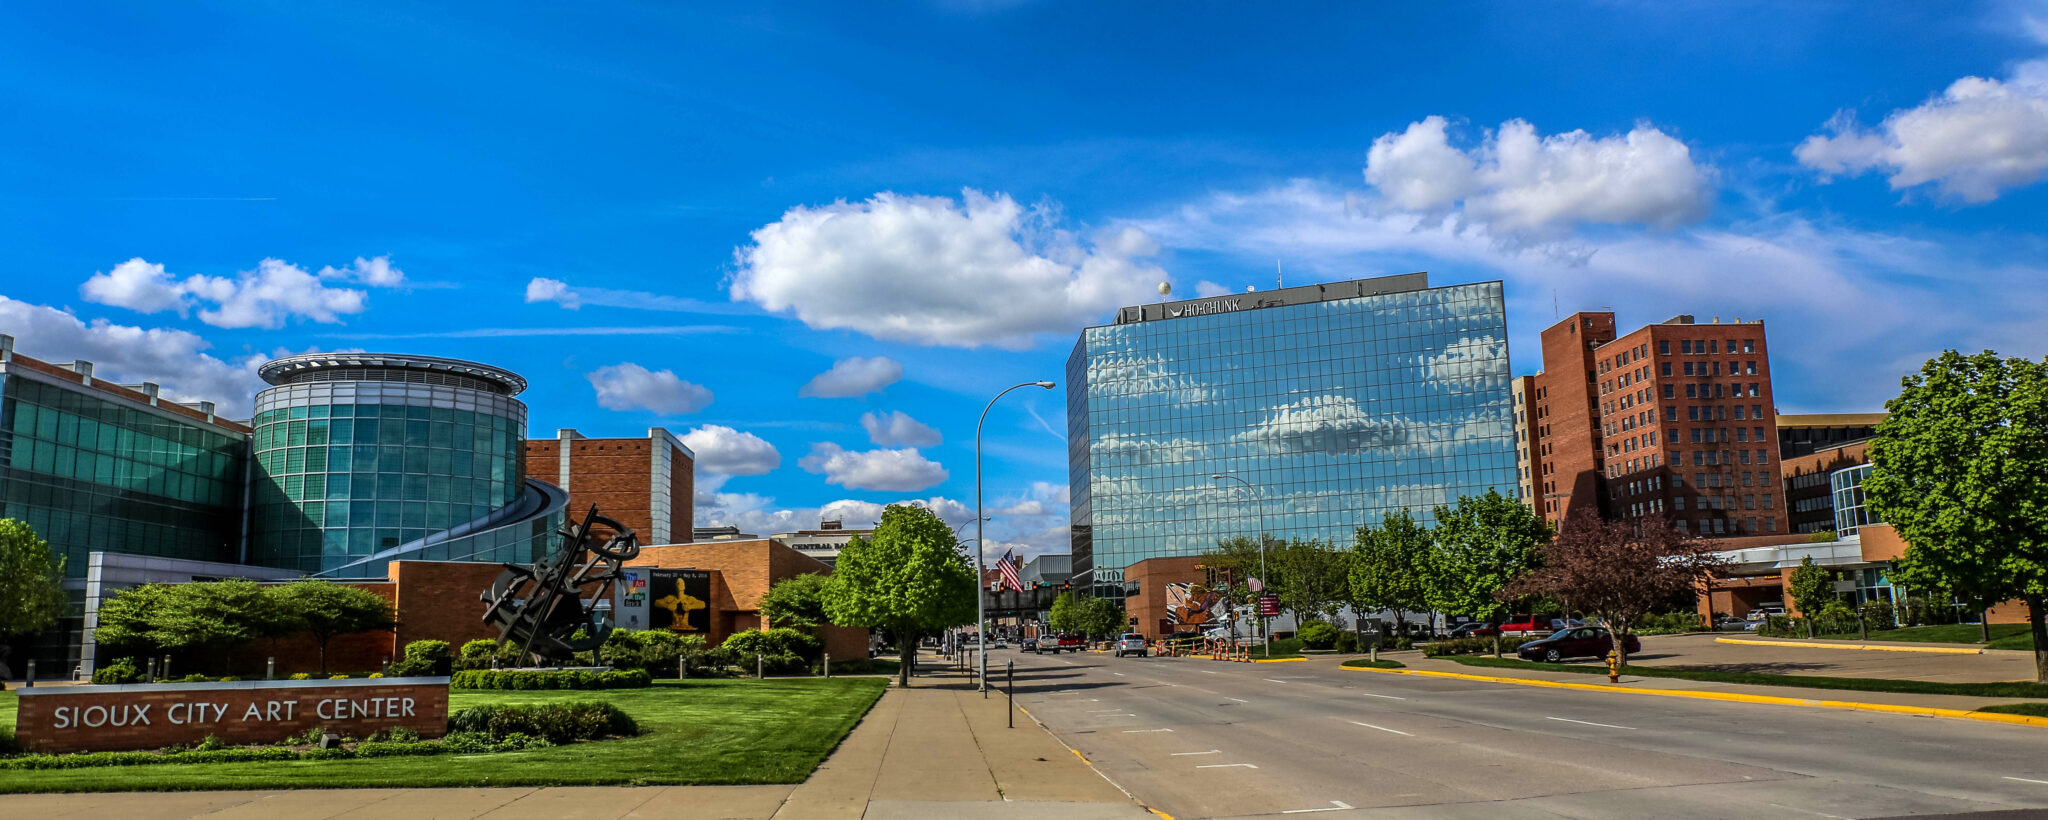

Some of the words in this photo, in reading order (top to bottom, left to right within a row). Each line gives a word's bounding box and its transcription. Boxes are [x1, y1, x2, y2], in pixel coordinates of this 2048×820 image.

[53, 703, 152, 729] SIOUX
[167, 702, 230, 726] CITY
[242, 700, 299, 721] ART
[316, 697, 417, 720] CENTER
